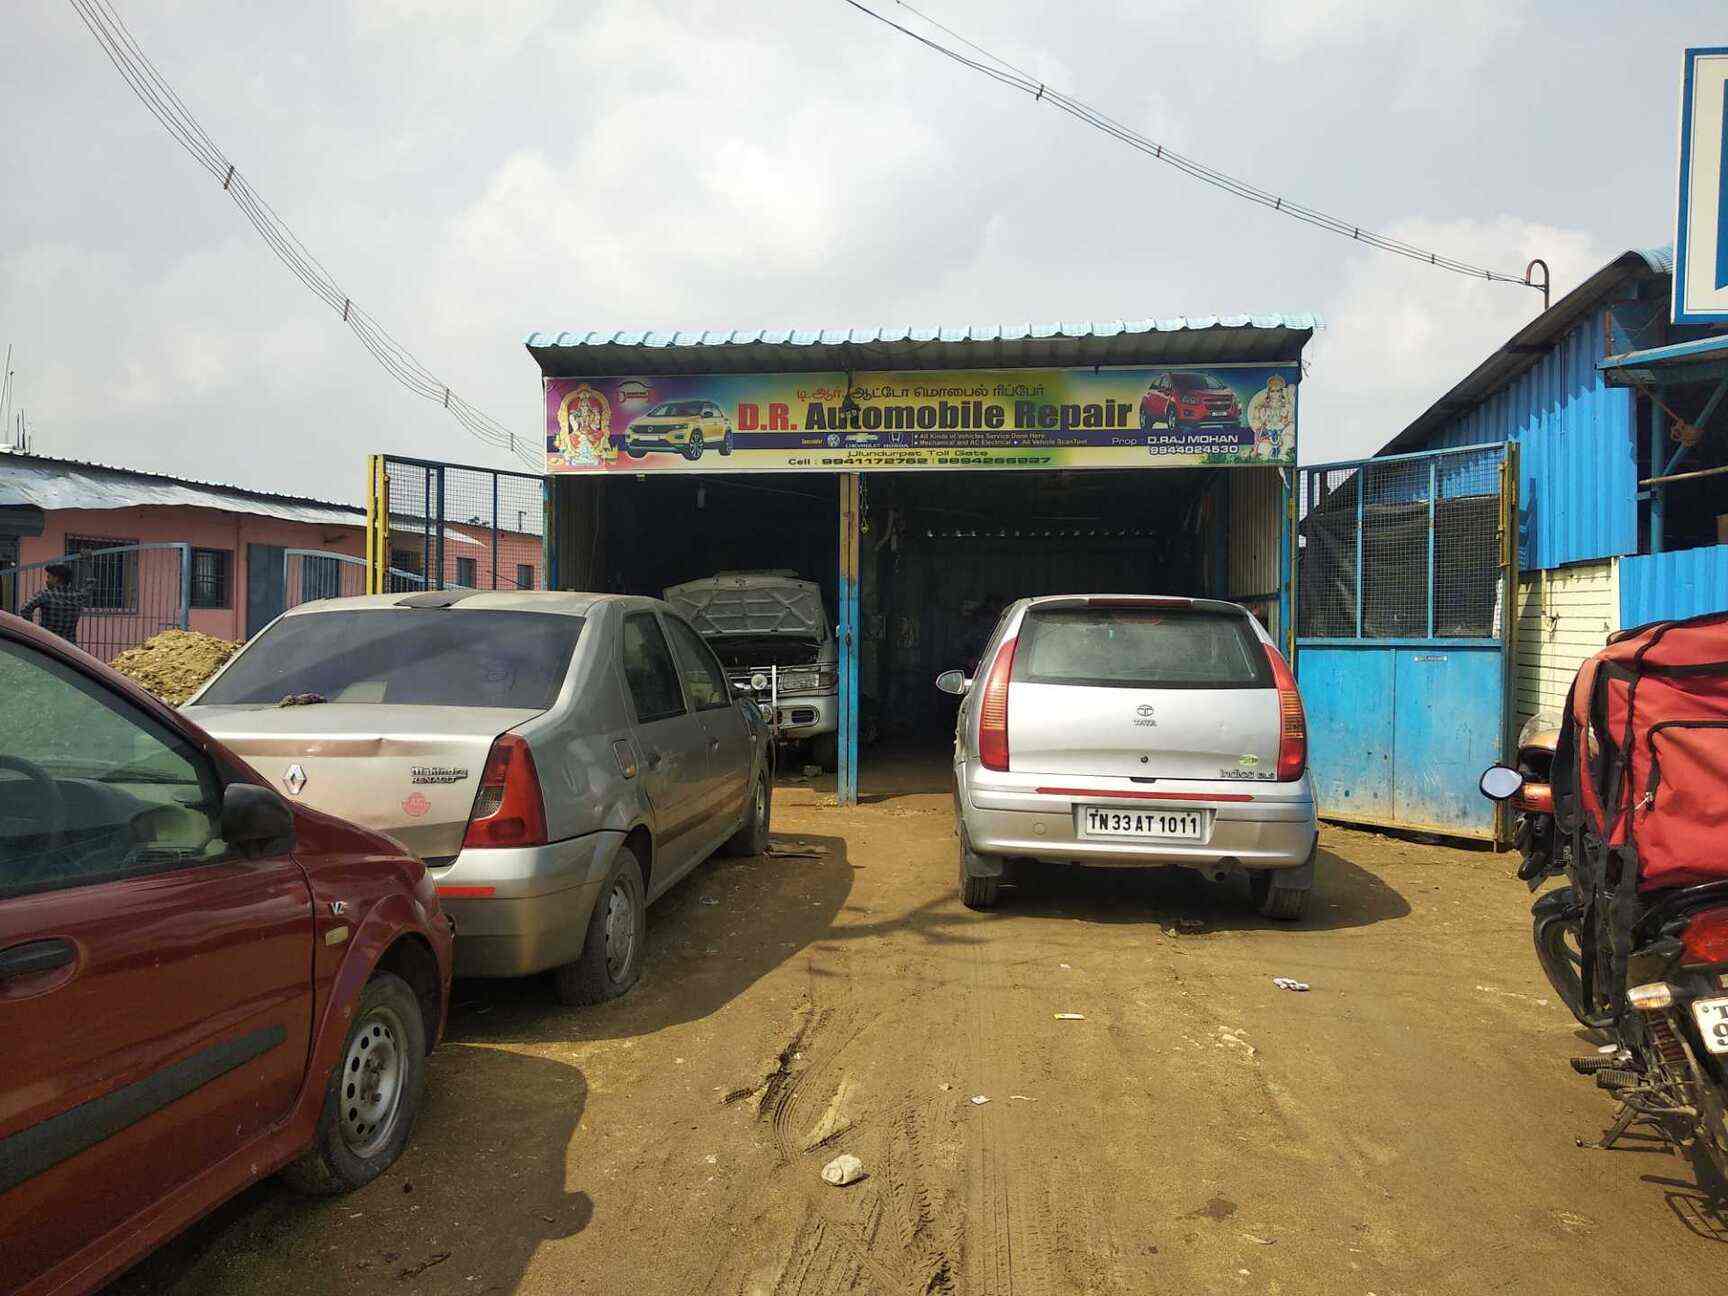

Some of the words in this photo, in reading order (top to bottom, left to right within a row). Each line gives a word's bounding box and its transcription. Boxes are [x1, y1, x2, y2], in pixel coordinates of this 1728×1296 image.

[913, 383, 989, 398] மொபைல்
[738, 402, 798, 431] D.R.
[804, 400, 1005, 430] Automobile
[1014, 399, 1133, 432] Repair
[788, 458, 811, 466] Cell
[1089, 812, 1109, 830] TN
[1112, 814, 1132, 831] 33
[1135, 815, 1155, 832] AT
[1159, 816, 1198, 834] 1011
